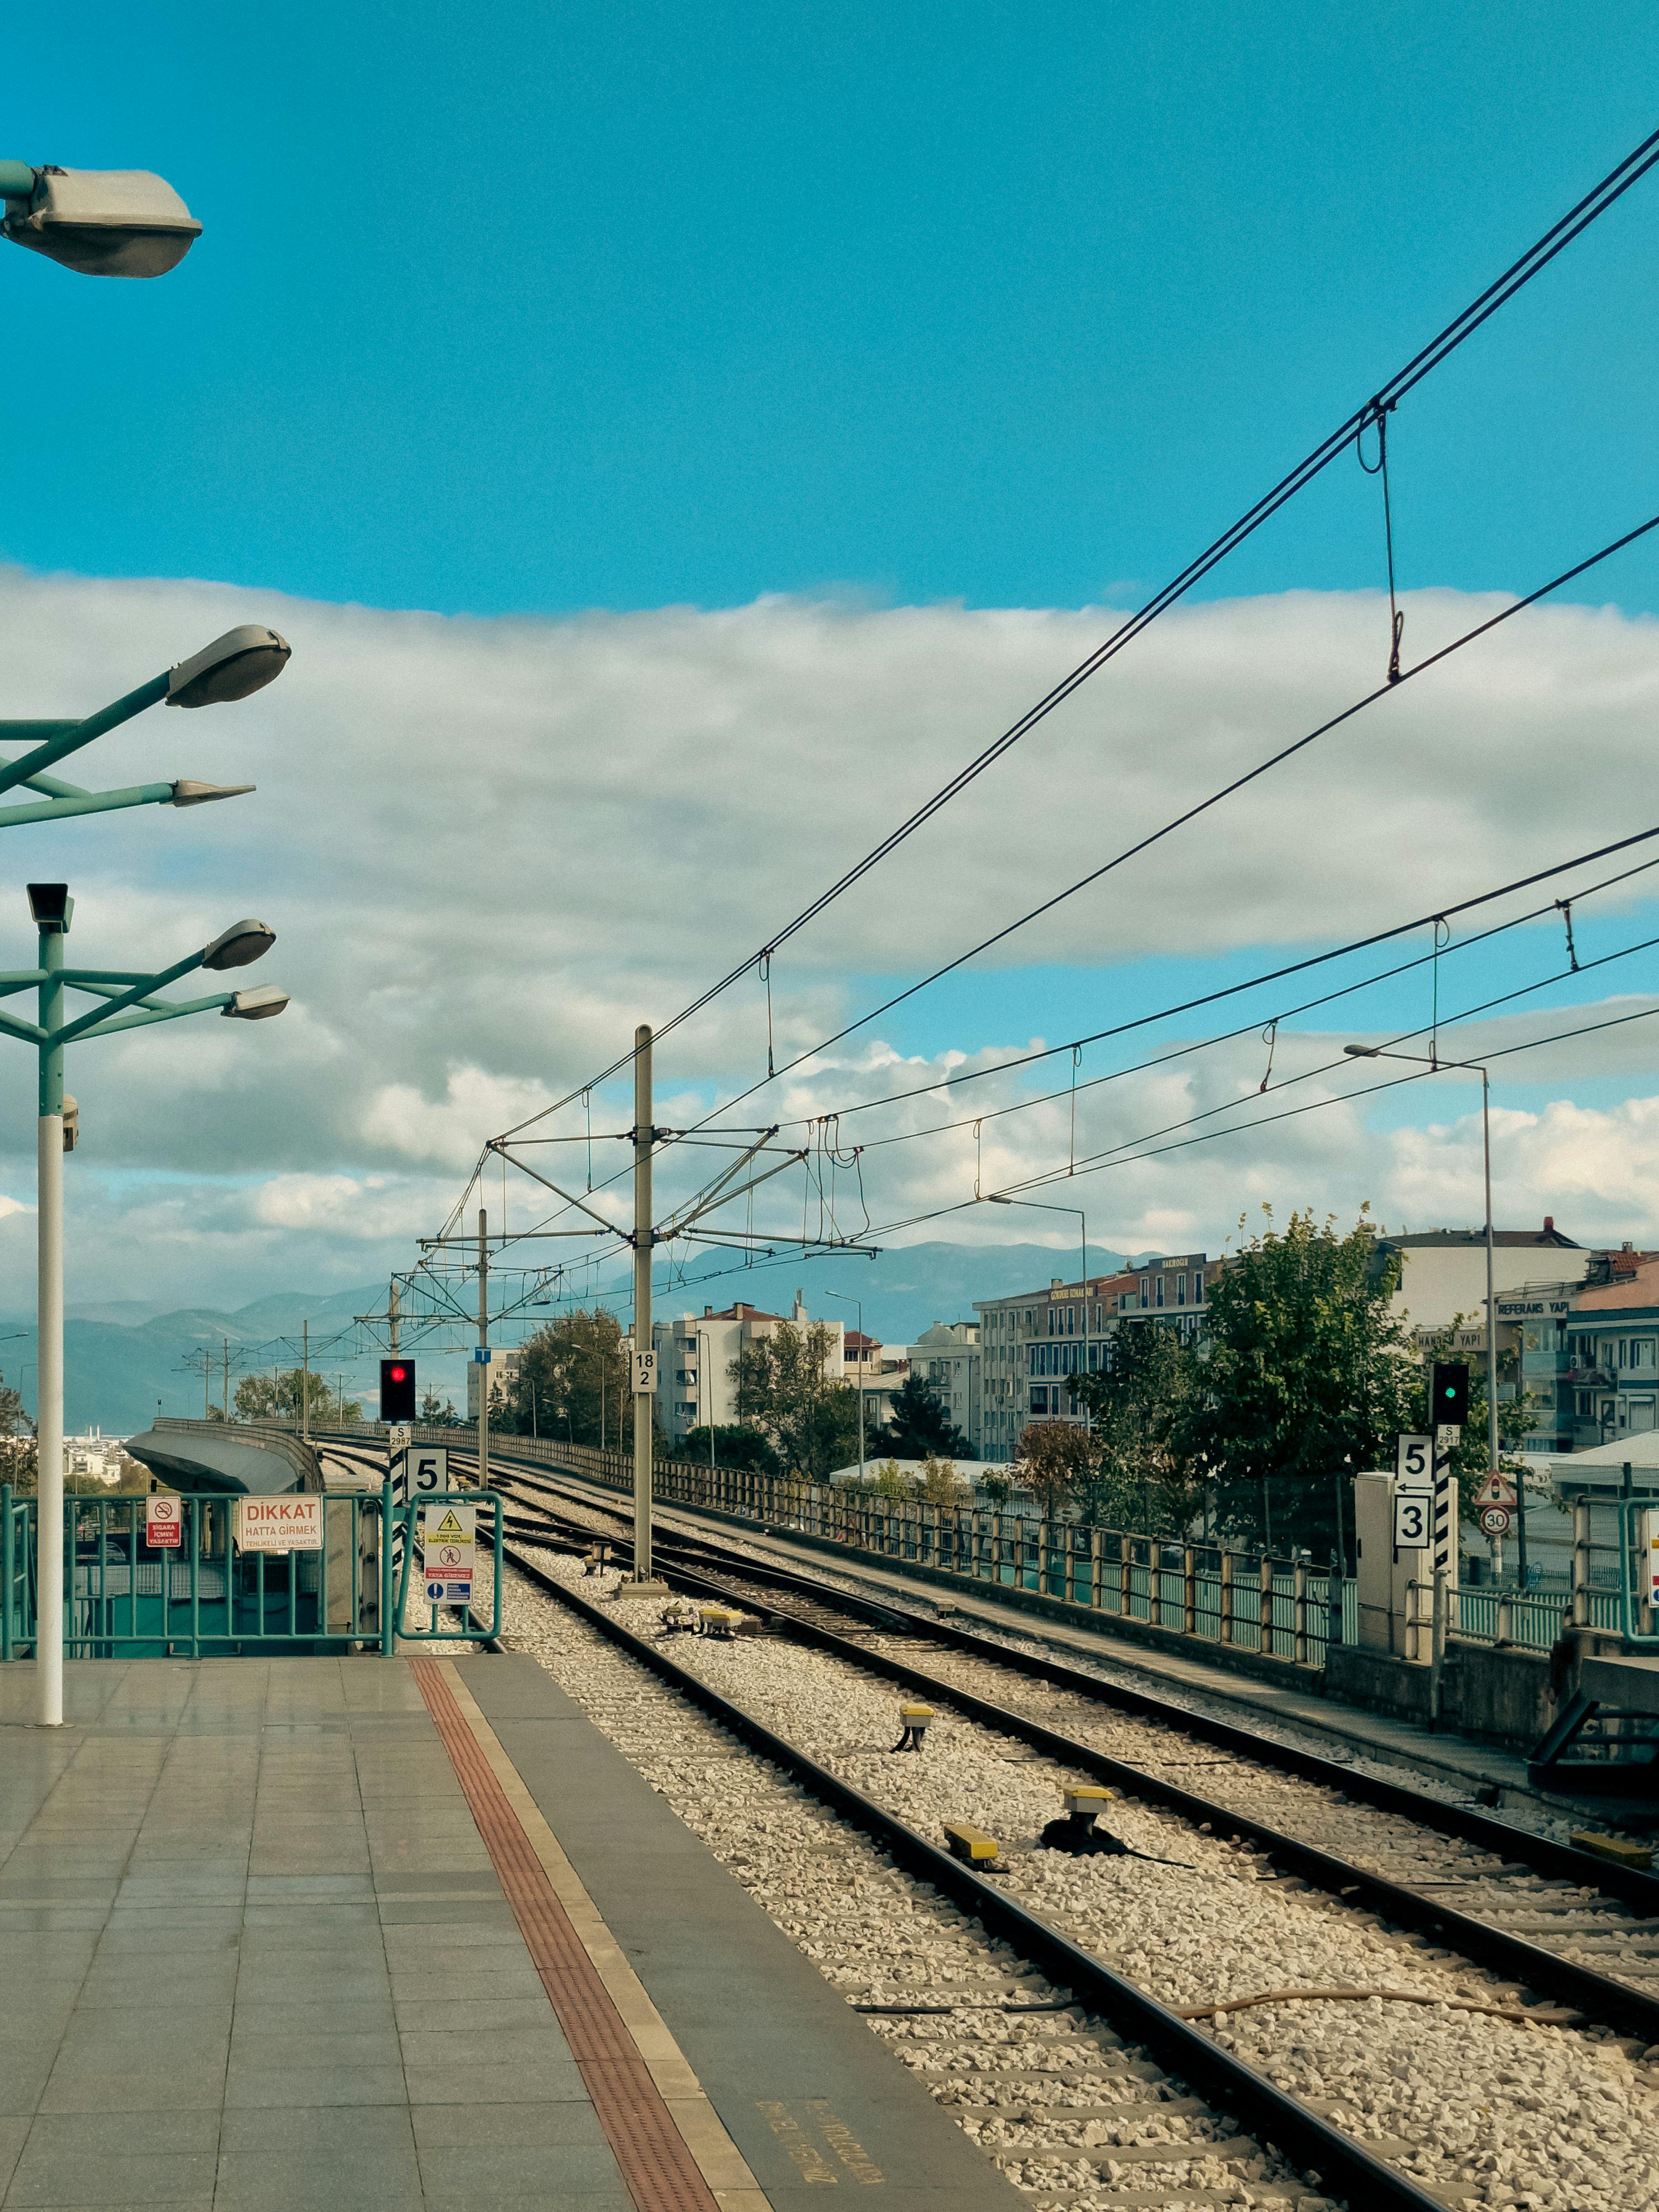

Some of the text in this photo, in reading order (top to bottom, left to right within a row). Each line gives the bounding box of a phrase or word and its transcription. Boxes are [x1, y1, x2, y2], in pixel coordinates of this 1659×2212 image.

[1498, 1301, 1569, 1314] REFERANS YAPI
[1460, 1334, 1480, 1346] YAPI
[636, 1354, 654, 1368] 18
[640, 1371, 649, 1385] 2
[398, 1428, 404, 1437] S
[1446, 1427, 1453, 1436] S
[1405, 1444, 1425, 1474] 5
[416, 1459, 437, 1490] 5
[247, 1501, 316, 1520] DİKKAT
[1401, 1506, 1422, 1538] 3
[1486, 1514, 1505, 1527] 30
[246, 1524, 317, 1536] HATTA GİRMEK
